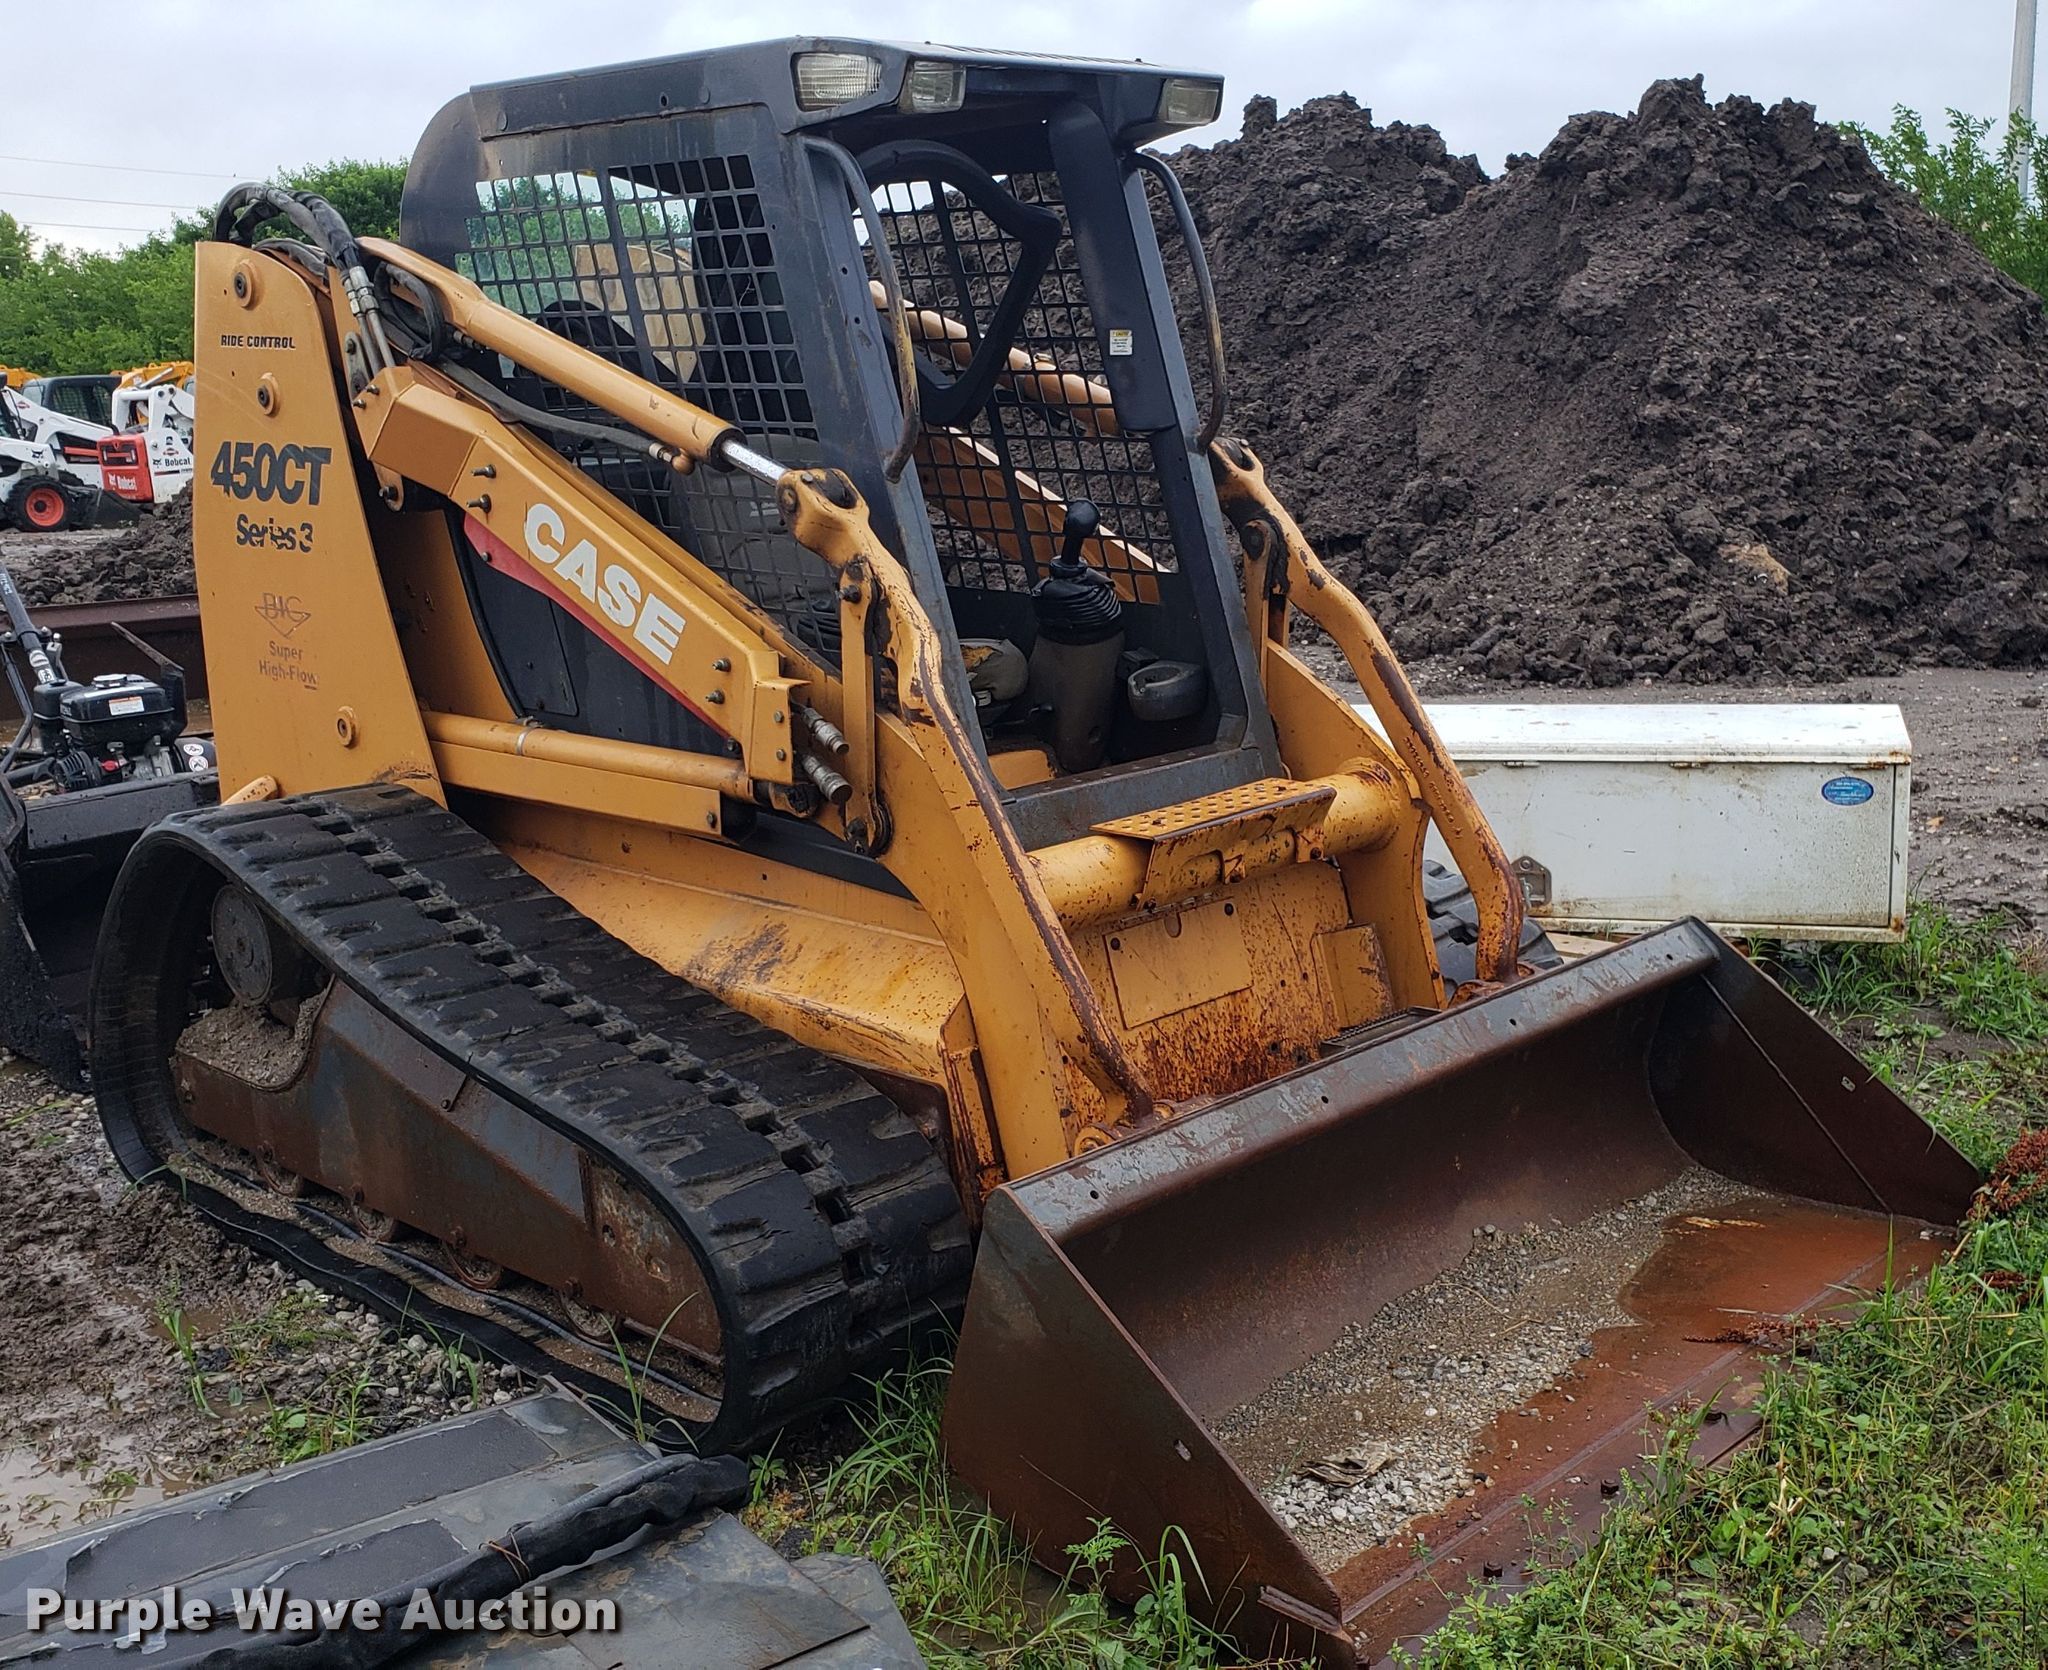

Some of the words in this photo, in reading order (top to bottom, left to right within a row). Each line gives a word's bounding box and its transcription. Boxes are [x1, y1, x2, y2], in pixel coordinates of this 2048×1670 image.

[220, 334, 244, 347] RIDE
[246, 335, 296, 349] CONTROL
[164, 457, 191, 467] Bobcat
[210, 441, 332, 506] 450CT
[236, 513, 297, 550] Series
[299, 522, 313, 553] 3
[524, 502, 687, 666] CASE
[268, 640, 304, 661] Super
[258, 659, 319, 685] High-Flow
